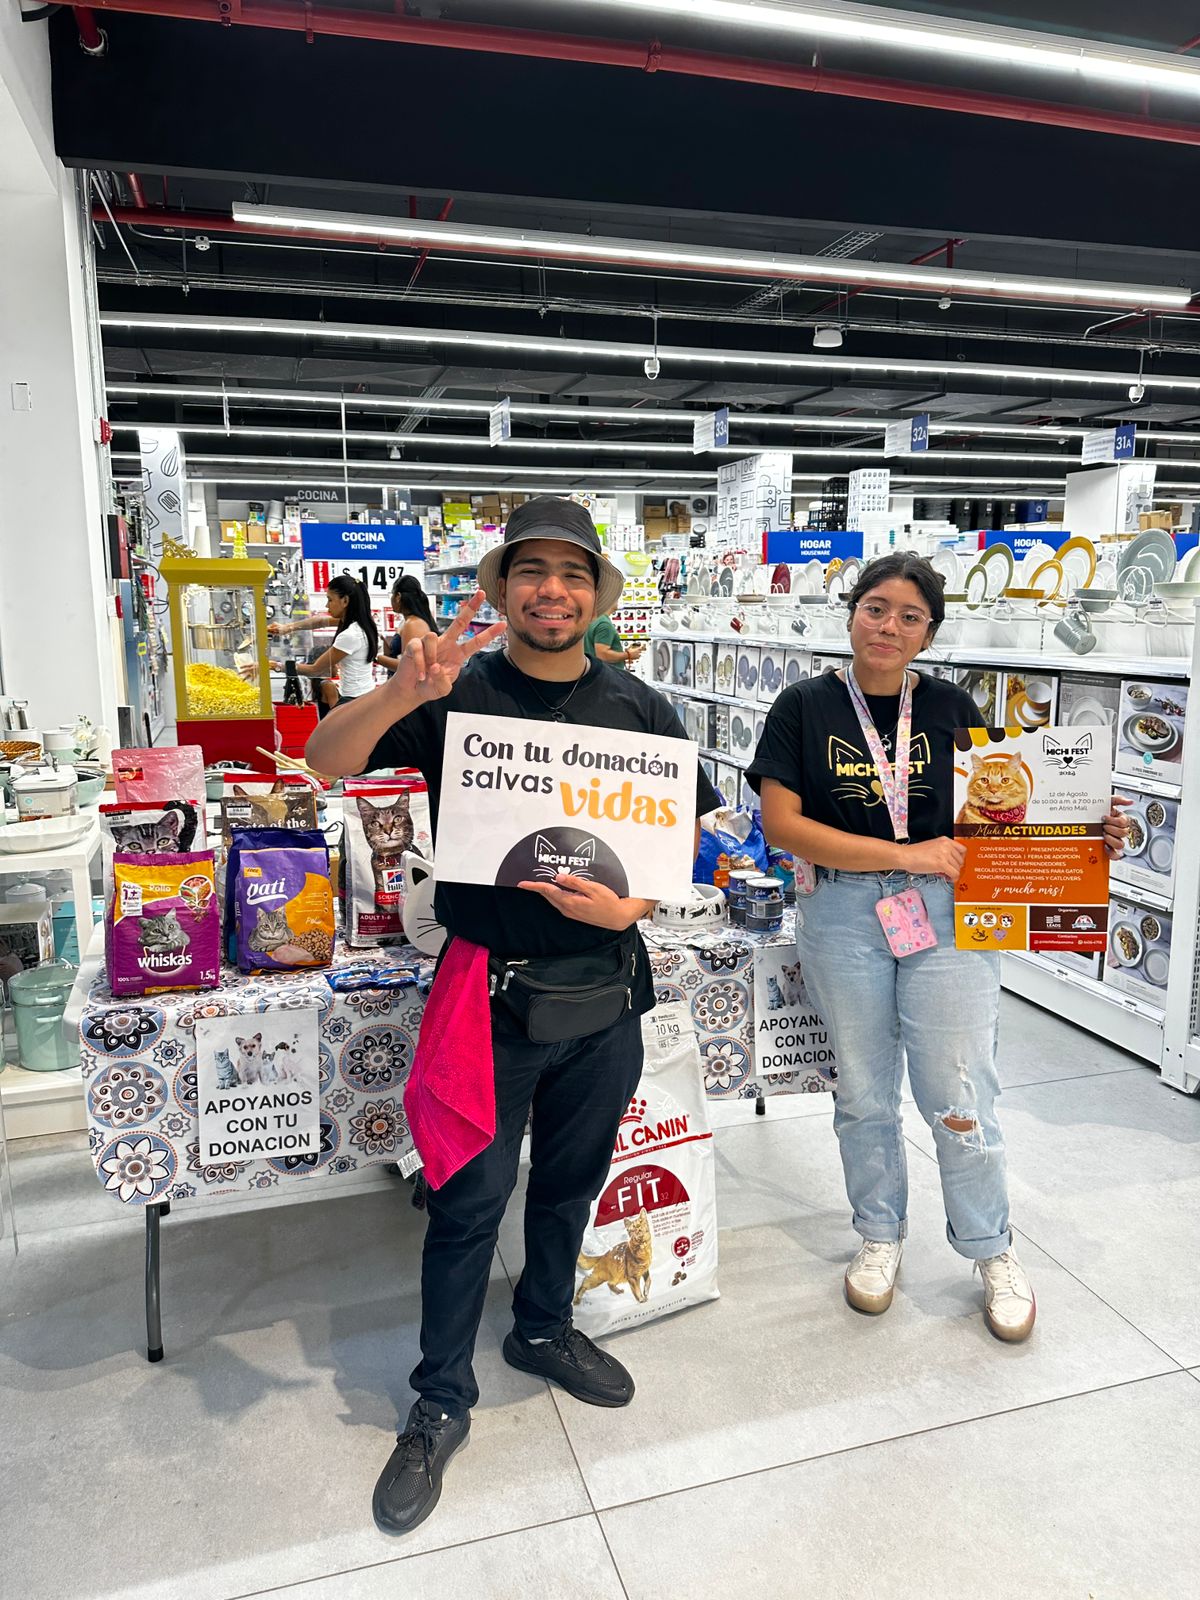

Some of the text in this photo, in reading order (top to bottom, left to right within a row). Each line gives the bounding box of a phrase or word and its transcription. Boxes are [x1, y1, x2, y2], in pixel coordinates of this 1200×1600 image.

[912, 427, 927, 442] 32A
[1116, 436, 1132, 450] 31A
[297, 490, 338, 501] COCINA
[341, 532, 386, 542] COCINA
[800, 540, 832, 549] HOGAR
[463, 733, 679, 779] Con tu donación
[1071, 747, 1089, 755] FEST
[836, 763, 880, 777] MICH
[460, 766, 678, 827] salvas vidas
[1003, 826, 1087, 835] ACTIVIDADES
[538, 854, 591, 867] MICHI FEST
[246, 877, 288, 905] gati
[992, 887, 1002, 899] y
[1003, 882, 1036, 894] mucho
[137, 952, 192, 968] whiskas
[656, 1022, 681, 1037] 10 kg
[759, 1014, 824, 1032] APOYAN
[775, 1031, 827, 1048] CON TU
[762, 1049, 836, 1068] DONACION
[205, 1090, 313, 1115] APOYANOS
[226, 1113, 298, 1134] CON TU
[631, 1114, 689, 1146] CANIN
[209, 1132, 310, 1157] DONACION
[623, 1171, 653, 1185] Regular
[617, 1177, 670, 1214] FIT 32
